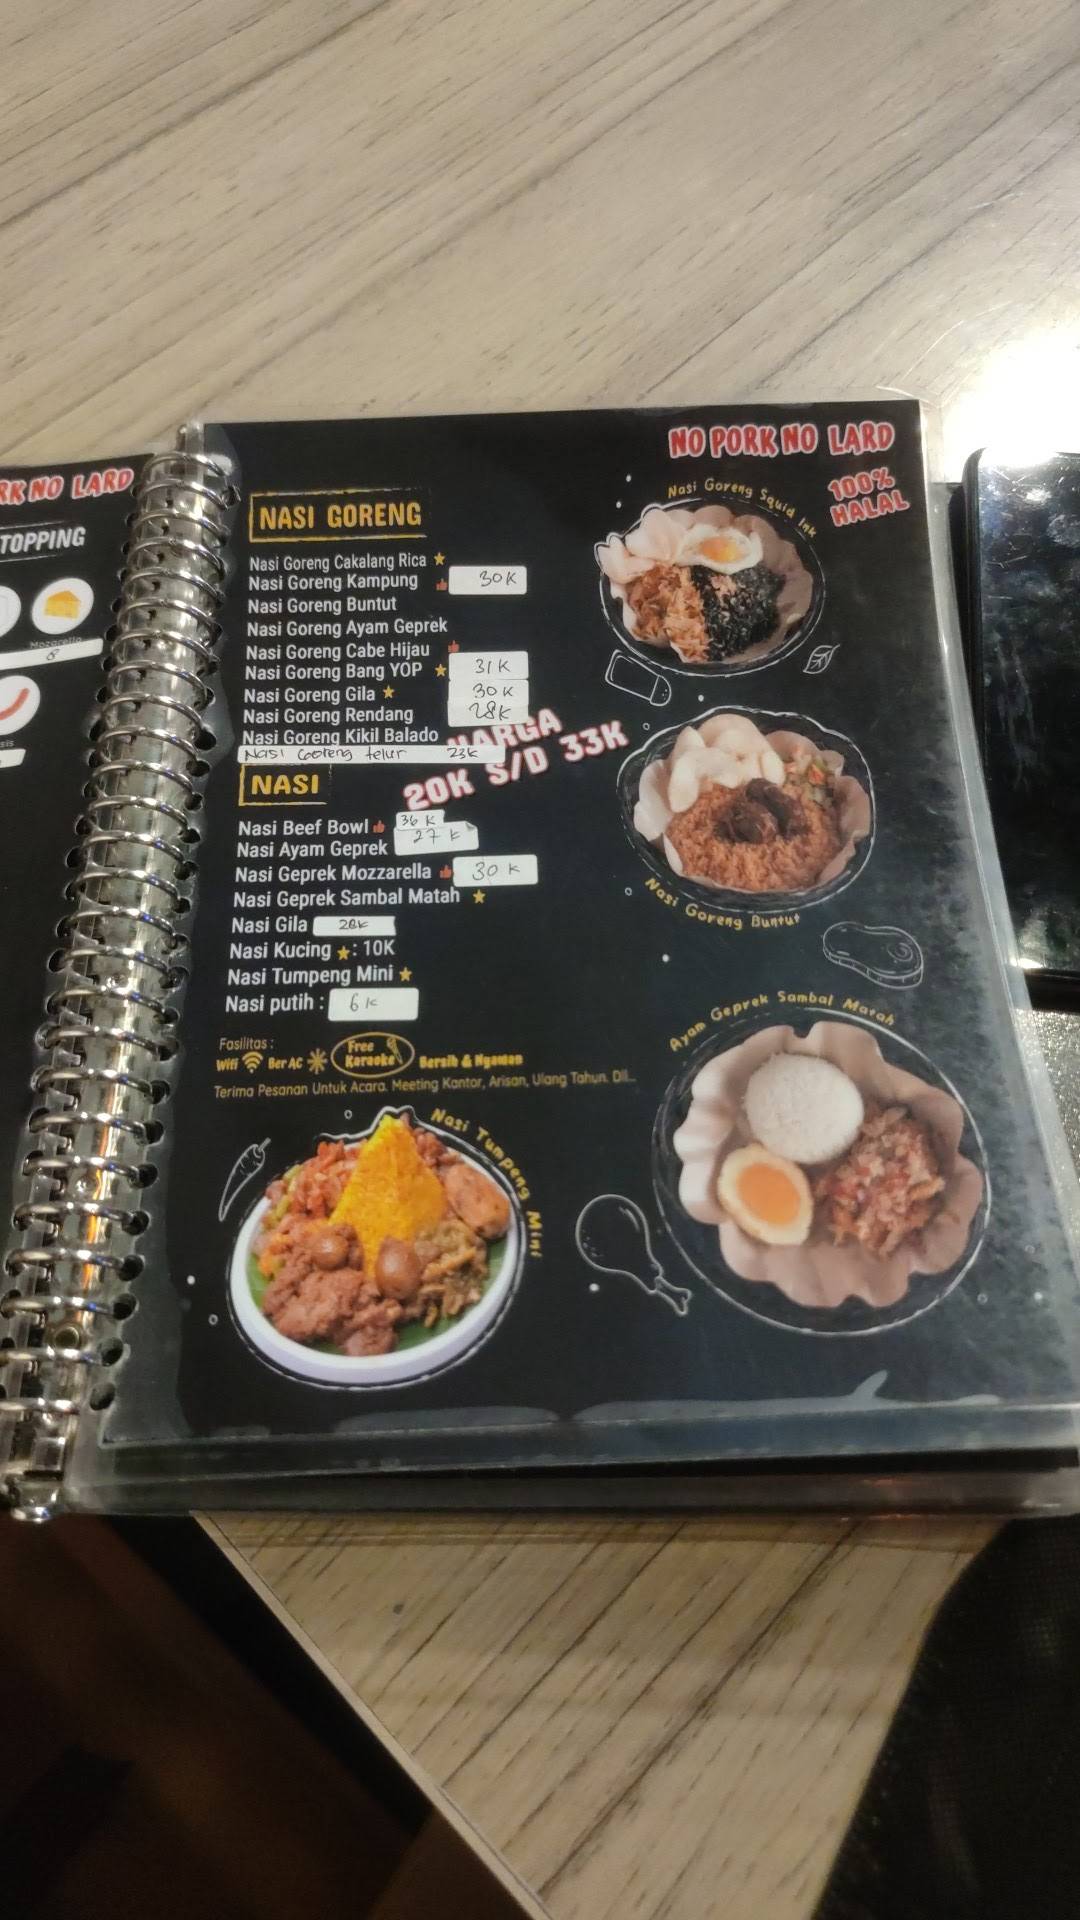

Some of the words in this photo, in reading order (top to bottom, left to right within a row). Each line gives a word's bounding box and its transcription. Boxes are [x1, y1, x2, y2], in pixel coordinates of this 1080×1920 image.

[668, 427, 705, 458] NO
[709, 425, 778, 458] PORK
[781, 423, 818, 455] NO
[827, 420, 895, 455] LARD
[28, 475, 64, 502] NO
[71, 468, 134, 499] LARD
[828, 467, 895, 500] 100%
[259, 505, 314, 530] NASI
[327, 503, 421, 528] GORENG
[668, 481, 697, 498] Nasi
[704, 478, 753, 497] Goreng
[760, 489, 796, 518] Squid
[797, 517, 817, 537] Ink
[830, 490, 910, 527] HALAL
[0, 526, 86, 554] TOPPING
[250, 555, 279, 572] Nasi
[283, 554, 330, 574] Goreng
[334, 553, 394, 572] Cakalang
[398, 553, 427, 568] Rica
[249, 575, 282, 591] Nasi
[288, 574, 341, 594] Goreng
[347, 574, 418, 593] Kampung
[248, 598, 282, 614] Nasi
[287, 597, 341, 616] Goreng
[347, 597, 397, 612] Buntut
[247, 621, 282, 637] Nasi
[286, 620, 341, 640] Goreng
[346, 620, 389, 637] Ayam
[394, 618, 448, 636] Geprek
[246, 644, 281, 661] Nasi
[286, 644, 341, 664] Goreng
[346, 644, 385, 658] Cabe
[390, 642, 430, 660] Hijau
[245, 664, 281, 681] Nasi
[285, 664, 341, 684] Goreng
[346, 664, 384, 682] Bang
[389, 662, 422, 677] YOP
[244, 687, 279, 704] Nasi
[285, 687, 341, 706] Goreng
[345, 686, 376, 702] Gila
[243, 708, 278, 725] Nasi
[284, 708, 340, 727] Goreng
[346, 707, 414, 726] Rendang
[242, 730, 278, 745] Nasi
[283, 729, 340, 746] Goreng
[345, 729, 380, 744] Kikil
[384, 728, 439, 743] Balado
[245, 748, 284, 761] Nasi
[366, 748, 407, 760] telur
[402, 768, 476, 812] 20K
[484, 746, 549, 786] S/D
[559, 720, 629, 763] 33K
[251, 774, 320, 796] NASI
[238, 821, 277, 836] Nasi
[283, 819, 322, 835] Beef
[328, 819, 369, 835] Bowl
[236, 842, 274, 859] Nasi
[279, 842, 323, 860] Ayam
[330, 840, 388, 859] Geprek
[235, 866, 272, 884] Nasi
[277, 866, 337, 886] Geprek
[342, 863, 432, 880] Mozzarella
[233, 891, 271, 908] Nasi
[276, 890, 336, 909] Geprek
[340, 888, 403, 906] Sambal
[408, 886, 460, 904] Matah
[644, 877, 679, 907] Nasi
[685, 902, 743, 931] Goreng
[751, 913, 800, 929] Buntut
[231, 917, 269, 934] Nasi
[275, 916, 307, 932] Gila
[229, 943, 268, 960] Nasi
[274, 942, 332, 961] Kucing
[363, 940, 395, 956] 10K
[227, 969, 266, 986] Nasi
[272, 967, 351, 986] Tumpeng
[356, 964, 394, 983] Mini
[225, 995, 264, 1013] Nasi
[270, 992, 314, 1015] putih
[669, 1021, 706, 1051] Ayam
[710, 994, 769, 1021] Geprek
[777, 990, 834, 1007] Sambal
[842, 998, 895, 1026] Matah
[219, 1037, 267, 1051] Fasilitas
[348, 1039, 374, 1053] Free
[288, 1056, 303, 1069] AC
[345, 1054, 395, 1068] Karaoke
[214, 1085, 254, 1098] Terima
[258, 1083, 309, 1096] Pesanan
[312, 1081, 347, 1095] Untuk
[392, 1078, 439, 1092] Meeting
[532, 1072, 567, 1089] Ulang
[430, 1107, 470, 1133] Nasi
[476, 1125, 531, 1201] Tumpeng
[526, 1210, 543, 1258] Mini
